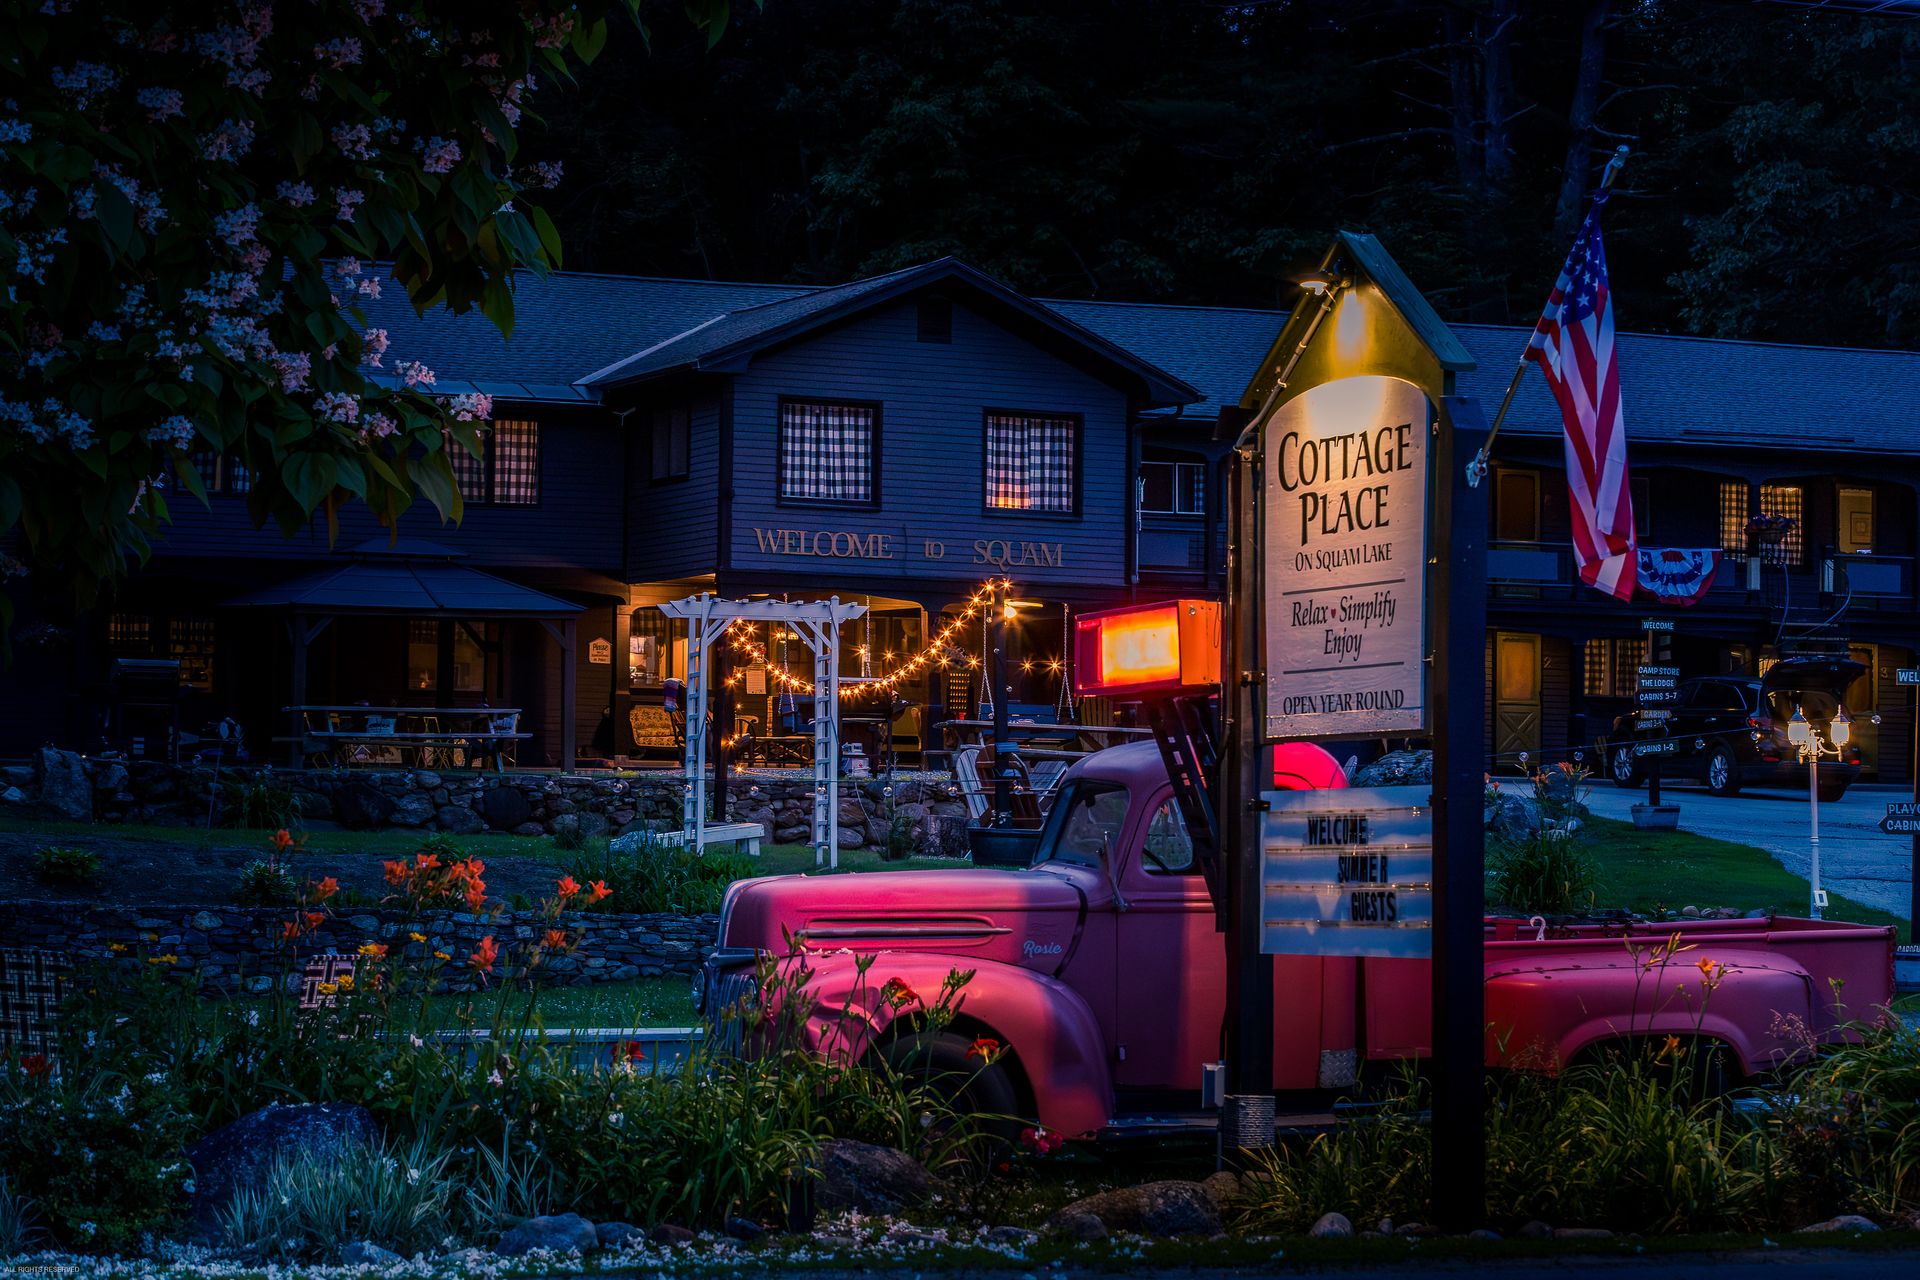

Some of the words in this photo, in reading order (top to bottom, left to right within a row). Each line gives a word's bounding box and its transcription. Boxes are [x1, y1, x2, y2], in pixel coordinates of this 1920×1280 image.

[1278, 423, 1412, 492] COTTAGE
[1299, 485, 1389, 546] PLACE
[753, 528, 893, 559] WELCOME
[973, 540, 1064, 573] SQUAM
[1295, 552, 1313, 572] ON
[1316, 547, 1360, 572] SQUAM
[1363, 543, 1393, 563] LAKE
[1291, 599, 1328, 626] Relax
[1340, 590, 1396, 629] Simplify
[1643, 621, 1674, 630] WELCOME
[1324, 627, 1362, 663] Enjoy
[1543, 656, 1552, 669] 2
[1638, 666, 1658, 675] CAMP
[1659, 668, 1680, 676] STORE
[1880, 667, 1889, 679] 3
[1283, 695, 1317, 716] OPEN
[1320, 693, 1352, 713] YEAR
[1356, 689, 1404, 711] ROUND
[1640, 692, 1664, 701] CABINS
[1308, 816, 1367, 845] WELCOME
[1351, 892, 1396, 922] GUESTS
[1023, 939, 1062, 959] Rosie
